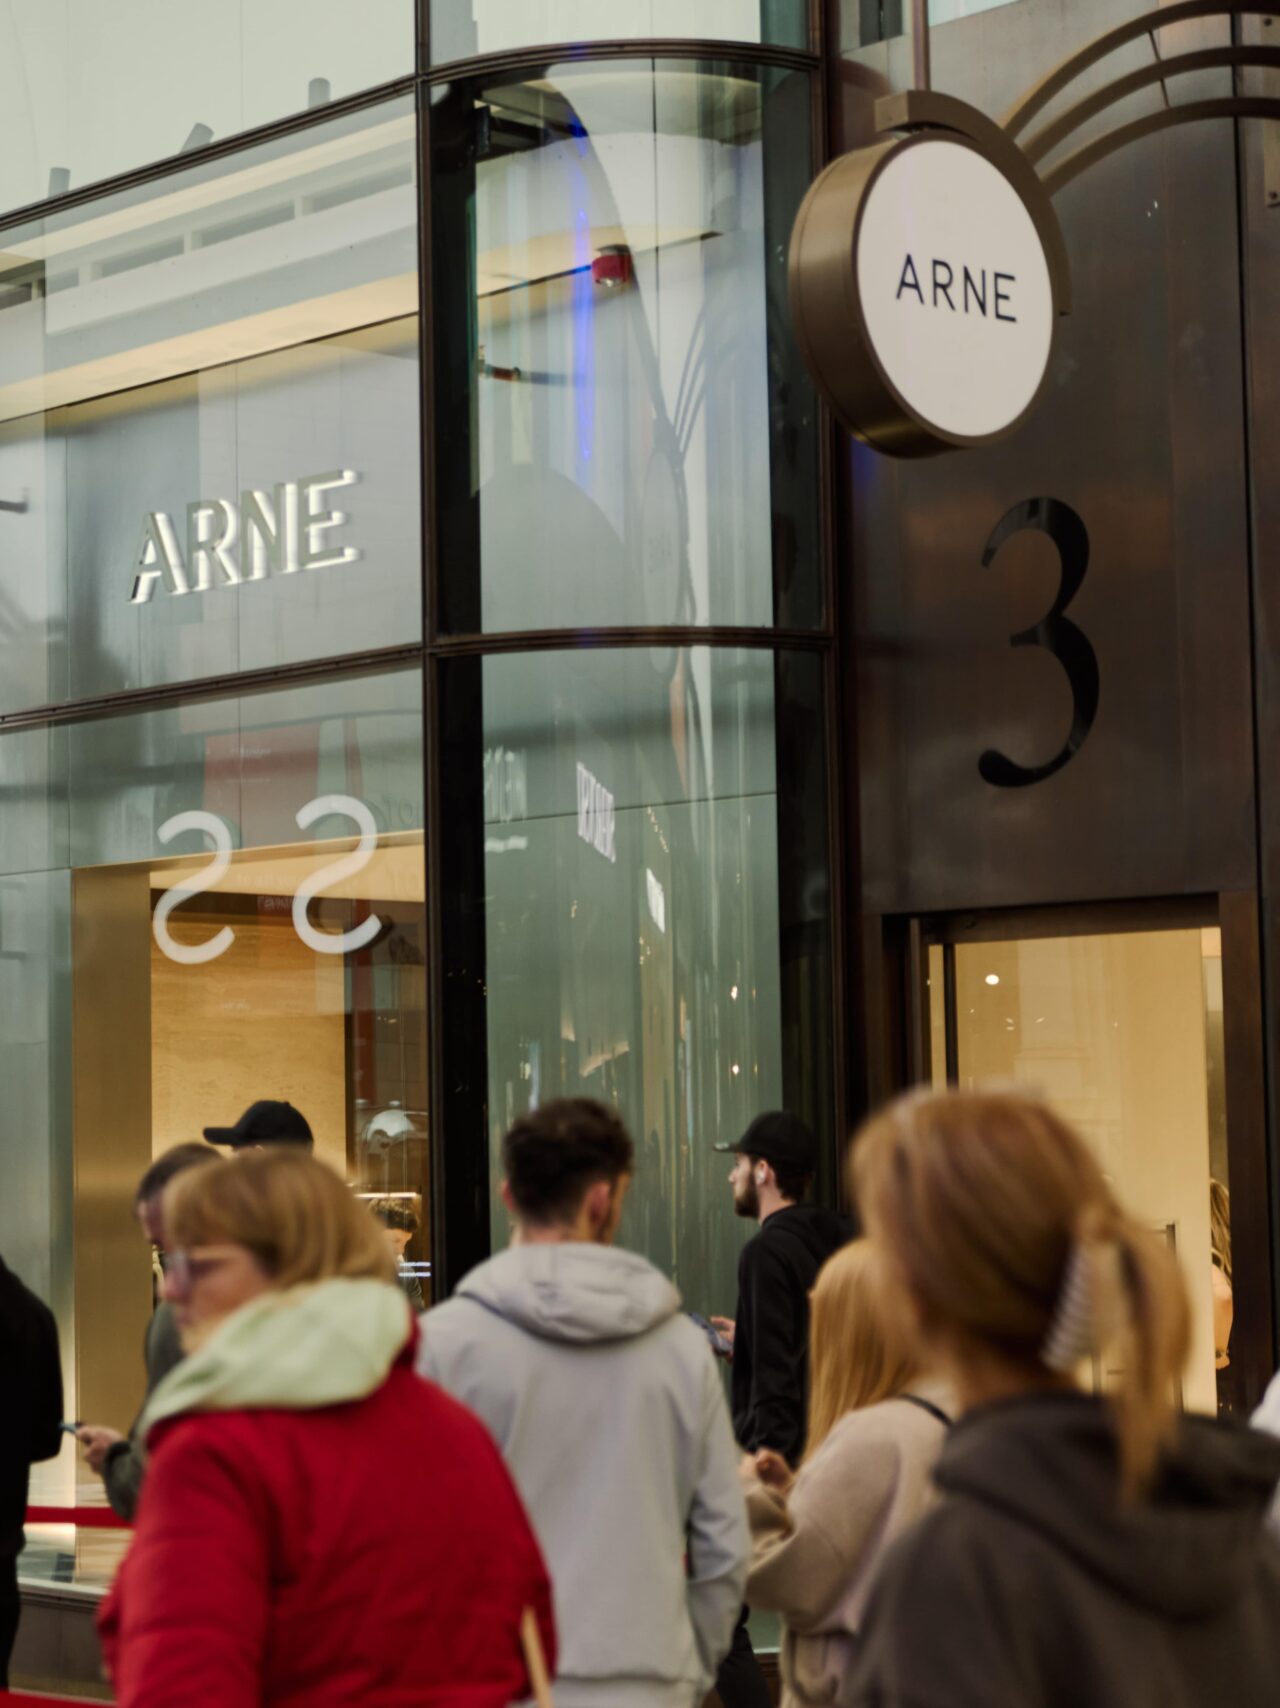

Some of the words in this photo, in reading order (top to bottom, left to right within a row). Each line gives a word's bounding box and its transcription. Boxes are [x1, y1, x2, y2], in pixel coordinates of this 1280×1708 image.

[896, 253, 1017, 323] ARNE
[127, 469, 361, 604] ARNE
[978, 496, 1099, 787] 3
